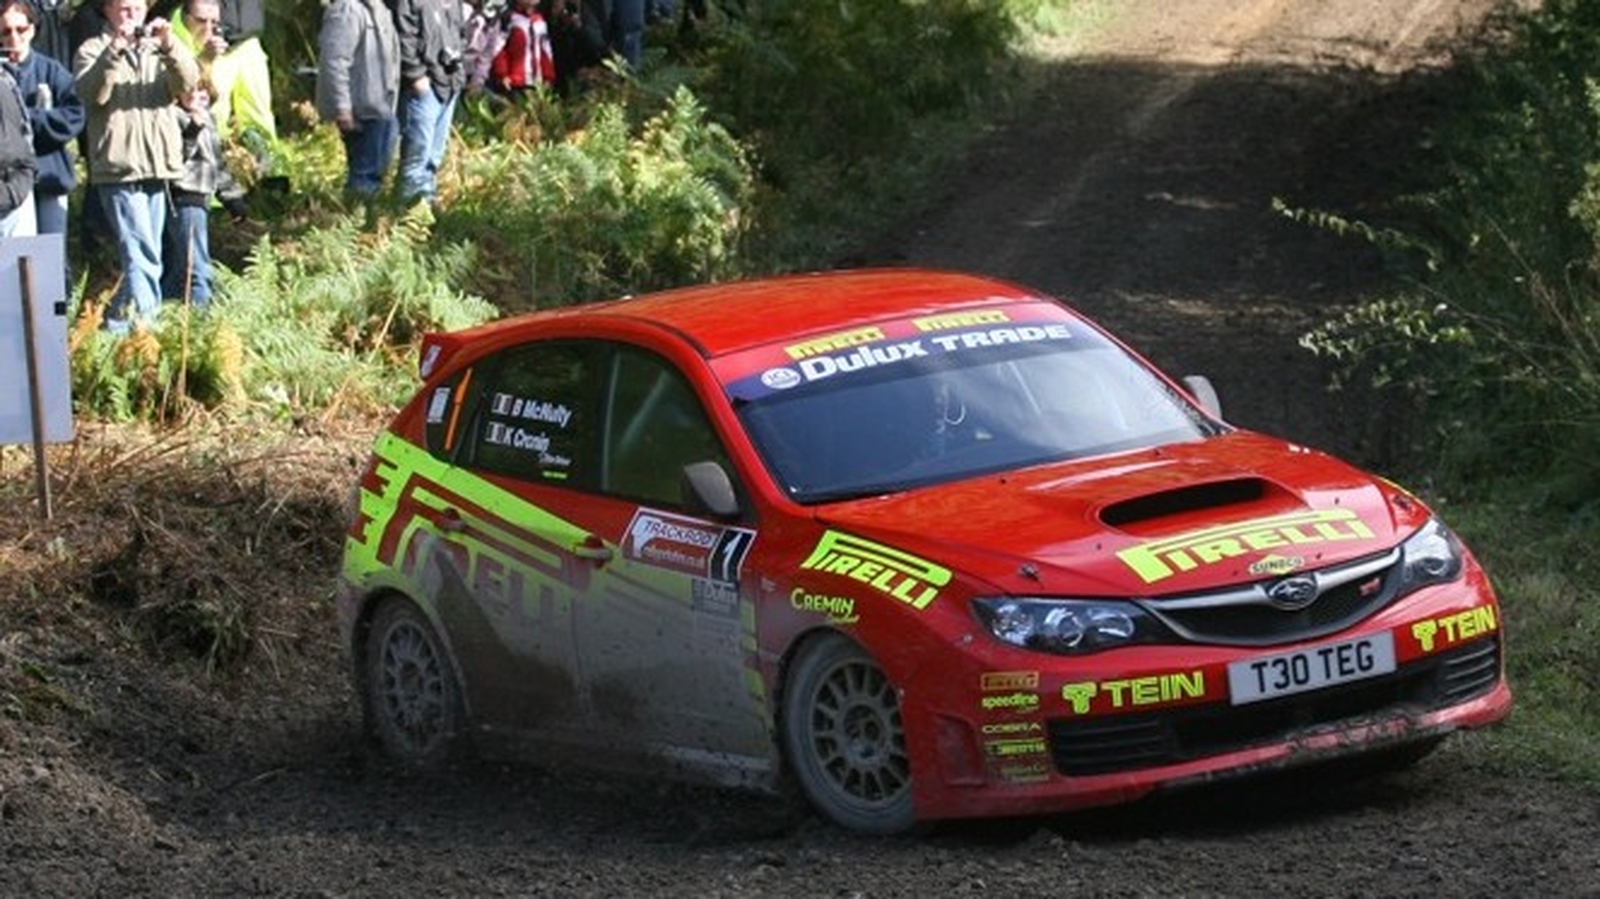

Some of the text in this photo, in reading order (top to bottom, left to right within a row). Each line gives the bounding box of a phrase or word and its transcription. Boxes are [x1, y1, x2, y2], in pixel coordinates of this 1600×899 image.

[800, 319, 1072, 381] Dulux TRADE
[512, 398, 572, 428] B McNulty
[503, 427, 550, 453] K Cronin
[644, 520, 713, 546] TRACKROD
[1115, 508, 1376, 583] PIRELLI
[723, 531, 743, 581] 1
[801, 529, 952, 610] PIRELLI
[1439, 604, 1497, 643] TEIN
[1100, 670, 1205, 707] TEIN
[1252, 641, 1374, 692] T30 TEG
